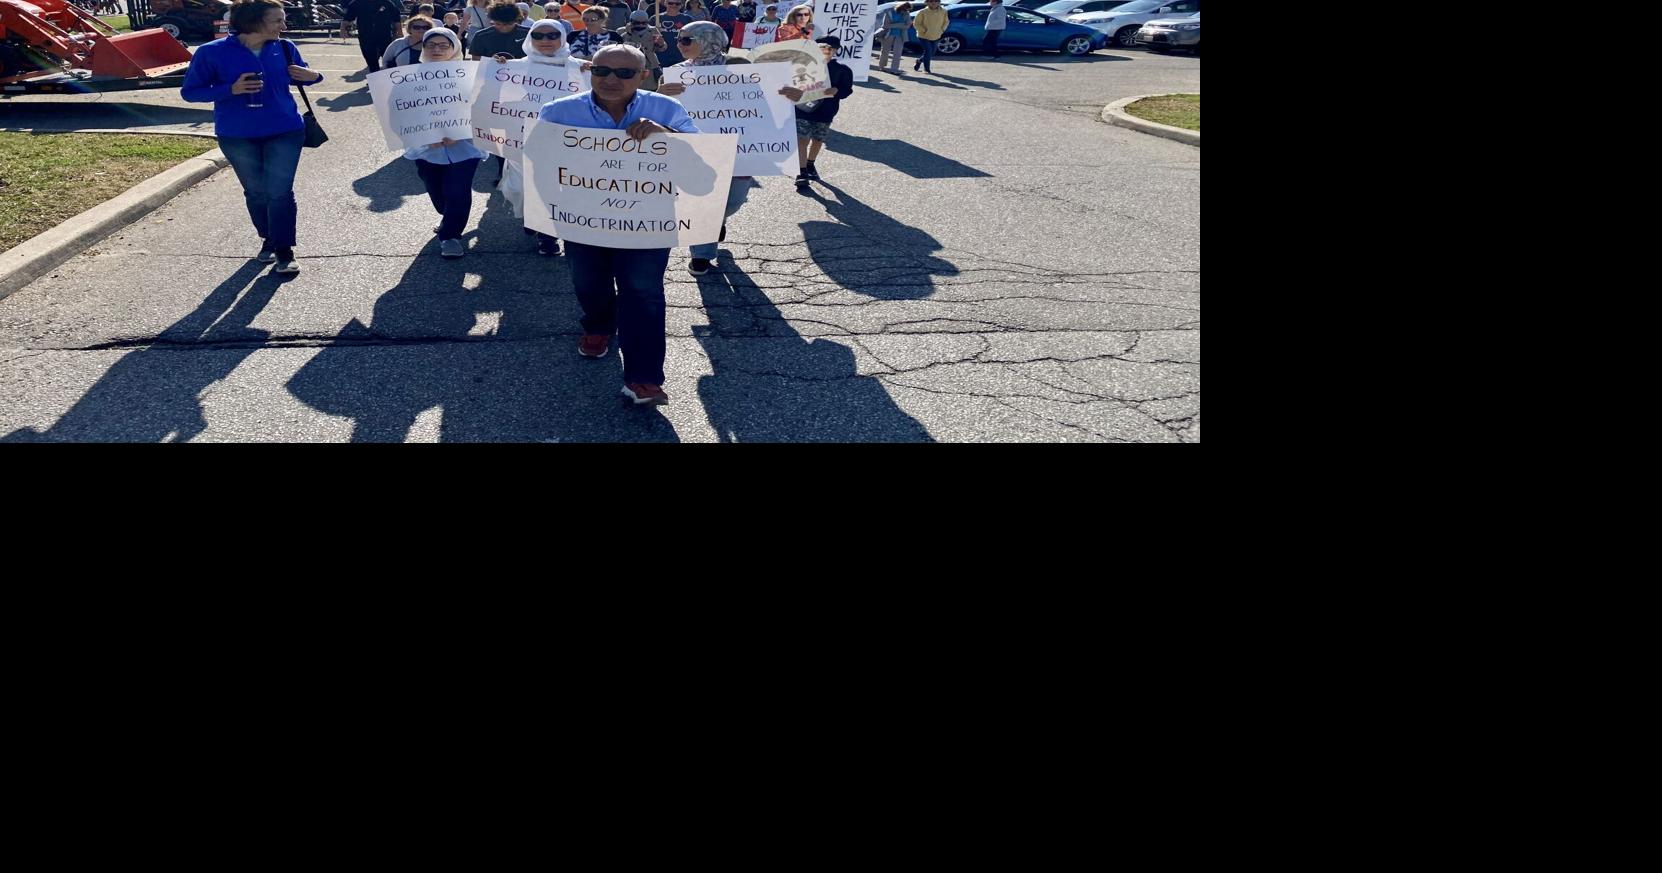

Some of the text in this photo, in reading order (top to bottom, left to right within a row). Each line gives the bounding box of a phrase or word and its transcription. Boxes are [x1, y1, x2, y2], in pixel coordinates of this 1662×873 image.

[823, 2, 868, 16] LEAVE
[831, 15, 859, 27] THE
[835, 45, 863, 59] ONE
[389, 68, 466, 85] SCHOOLS
[494, 67, 580, 93] SCHOOLS
[679, 70, 762, 86] SCHOOLS
[439, 82, 458, 90] FOR
[714, 90, 764, 101] ARE FOR
[429, 109, 449, 117] NOT
[491, 101, 540, 120] EDUCAT
[400, 118, 471, 136] INDOCTRINATI
[720, 126, 746, 135] NOT
[563, 129, 668, 156] SCHOOLS
[600, 159, 670, 173] ARE FOR
[600, 197, 641, 210] NOT
[549, 203, 692, 233] INDOCTRINATION
